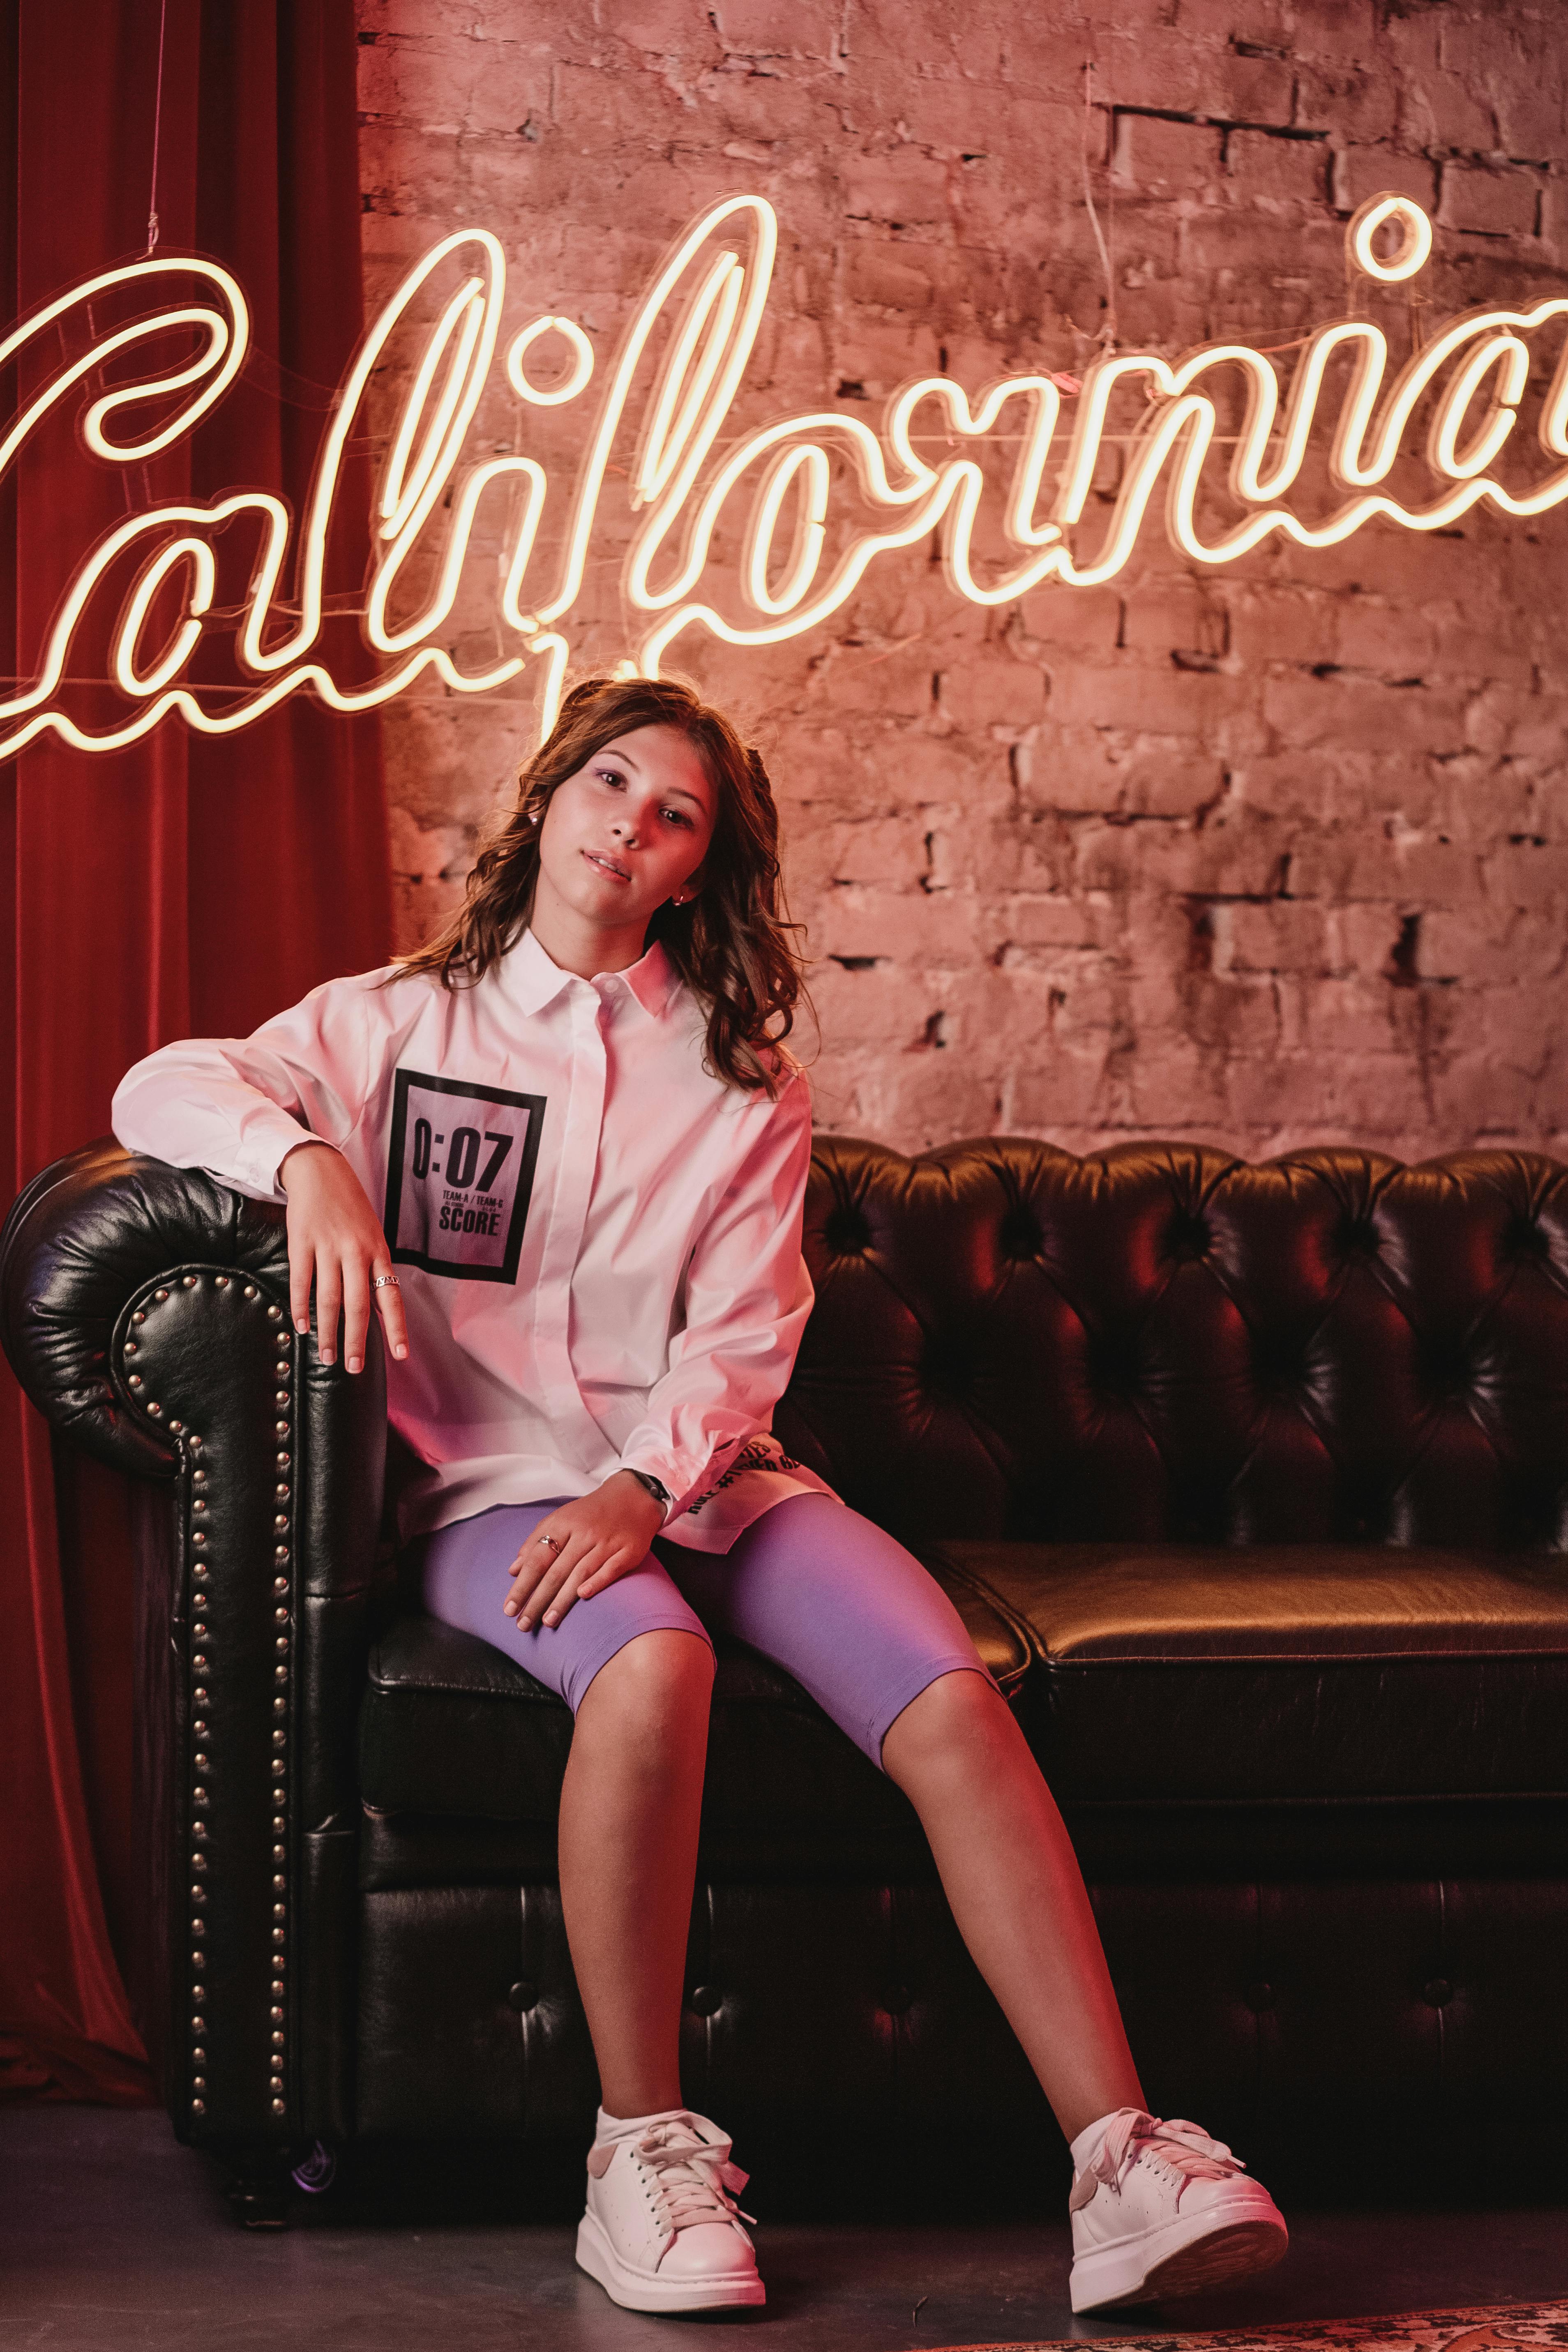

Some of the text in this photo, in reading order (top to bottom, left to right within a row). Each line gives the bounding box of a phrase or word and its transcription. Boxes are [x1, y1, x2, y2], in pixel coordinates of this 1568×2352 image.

[413, 1118, 514, 1192] 0:07
[443, 1190, 469, 1203] TEAM-A
[439, 1205, 501, 1236] SCORE
